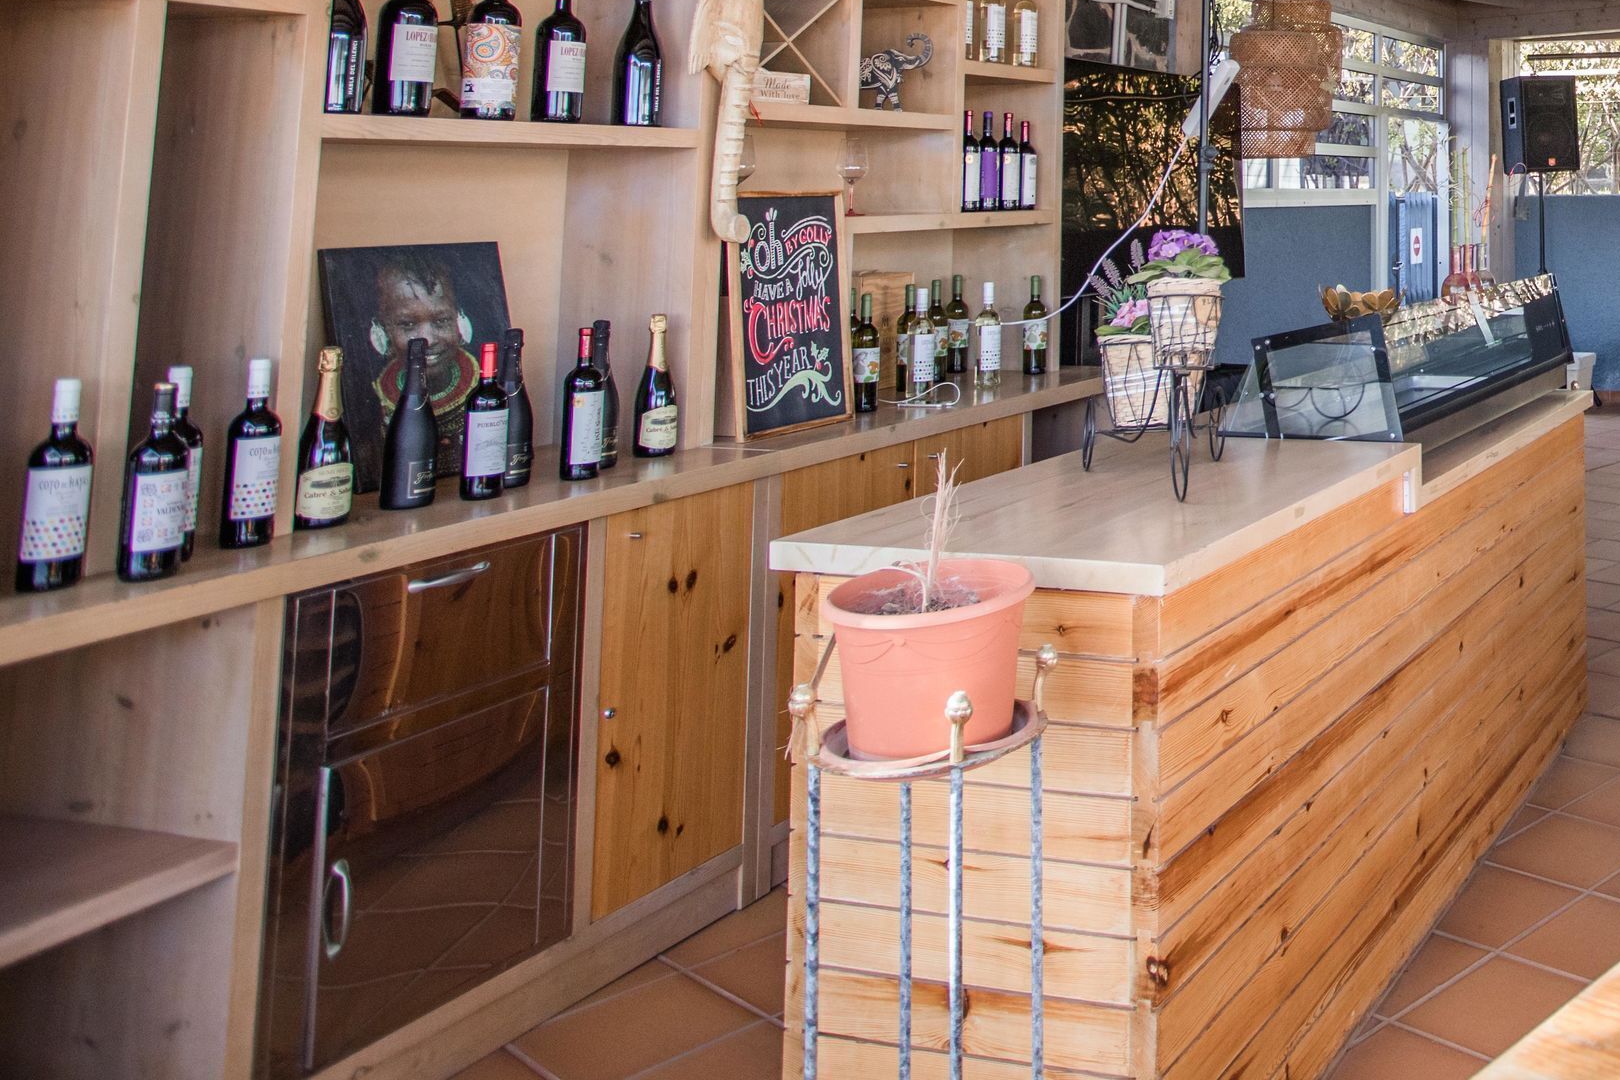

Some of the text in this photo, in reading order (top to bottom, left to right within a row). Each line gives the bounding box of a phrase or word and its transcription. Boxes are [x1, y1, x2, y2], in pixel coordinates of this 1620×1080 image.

[763, 76, 790, 89] Made
[785, 234, 799, 255] BY
[798, 226, 832, 247] GOLLY
[753, 280, 784, 301] HAVE
[785, 278, 794, 296] A
[744, 295, 831, 366] CHRISTMAS
[747, 346, 813, 406] THIS YEAR
